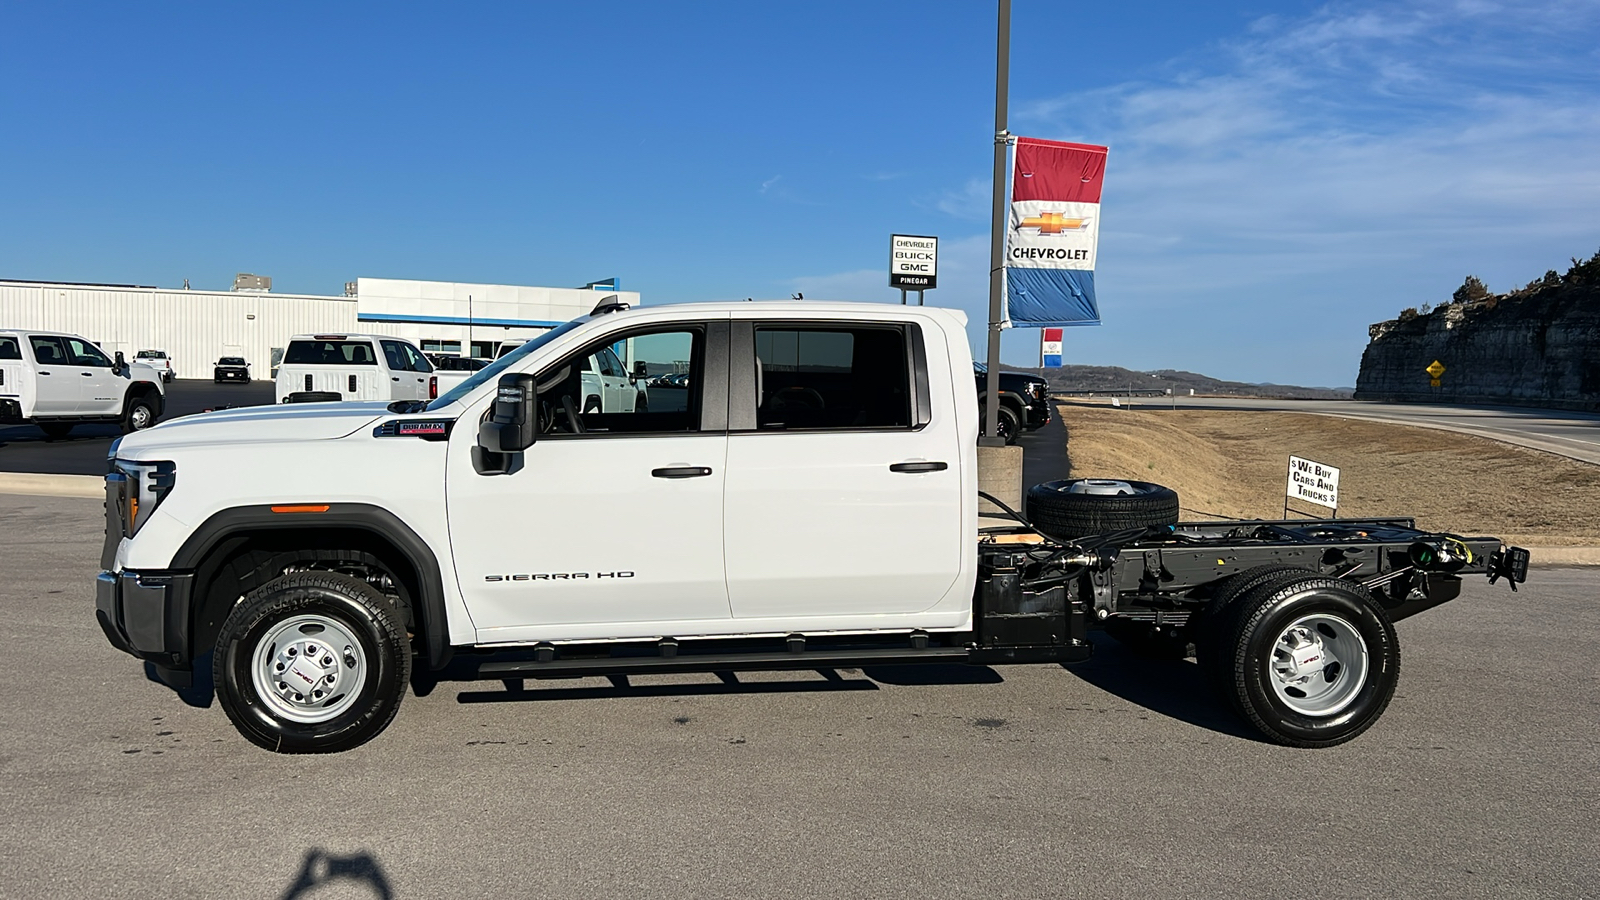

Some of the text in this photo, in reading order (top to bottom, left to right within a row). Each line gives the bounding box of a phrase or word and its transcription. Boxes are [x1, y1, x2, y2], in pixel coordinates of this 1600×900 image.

[896, 240, 934, 249] CHEVROLET
[895, 252, 934, 260] BUICK
[1013, 247, 1088, 260] CHEVROLET
[900, 263, 928, 271] GMC
[484, 571, 635, 582] SIERRA HD
